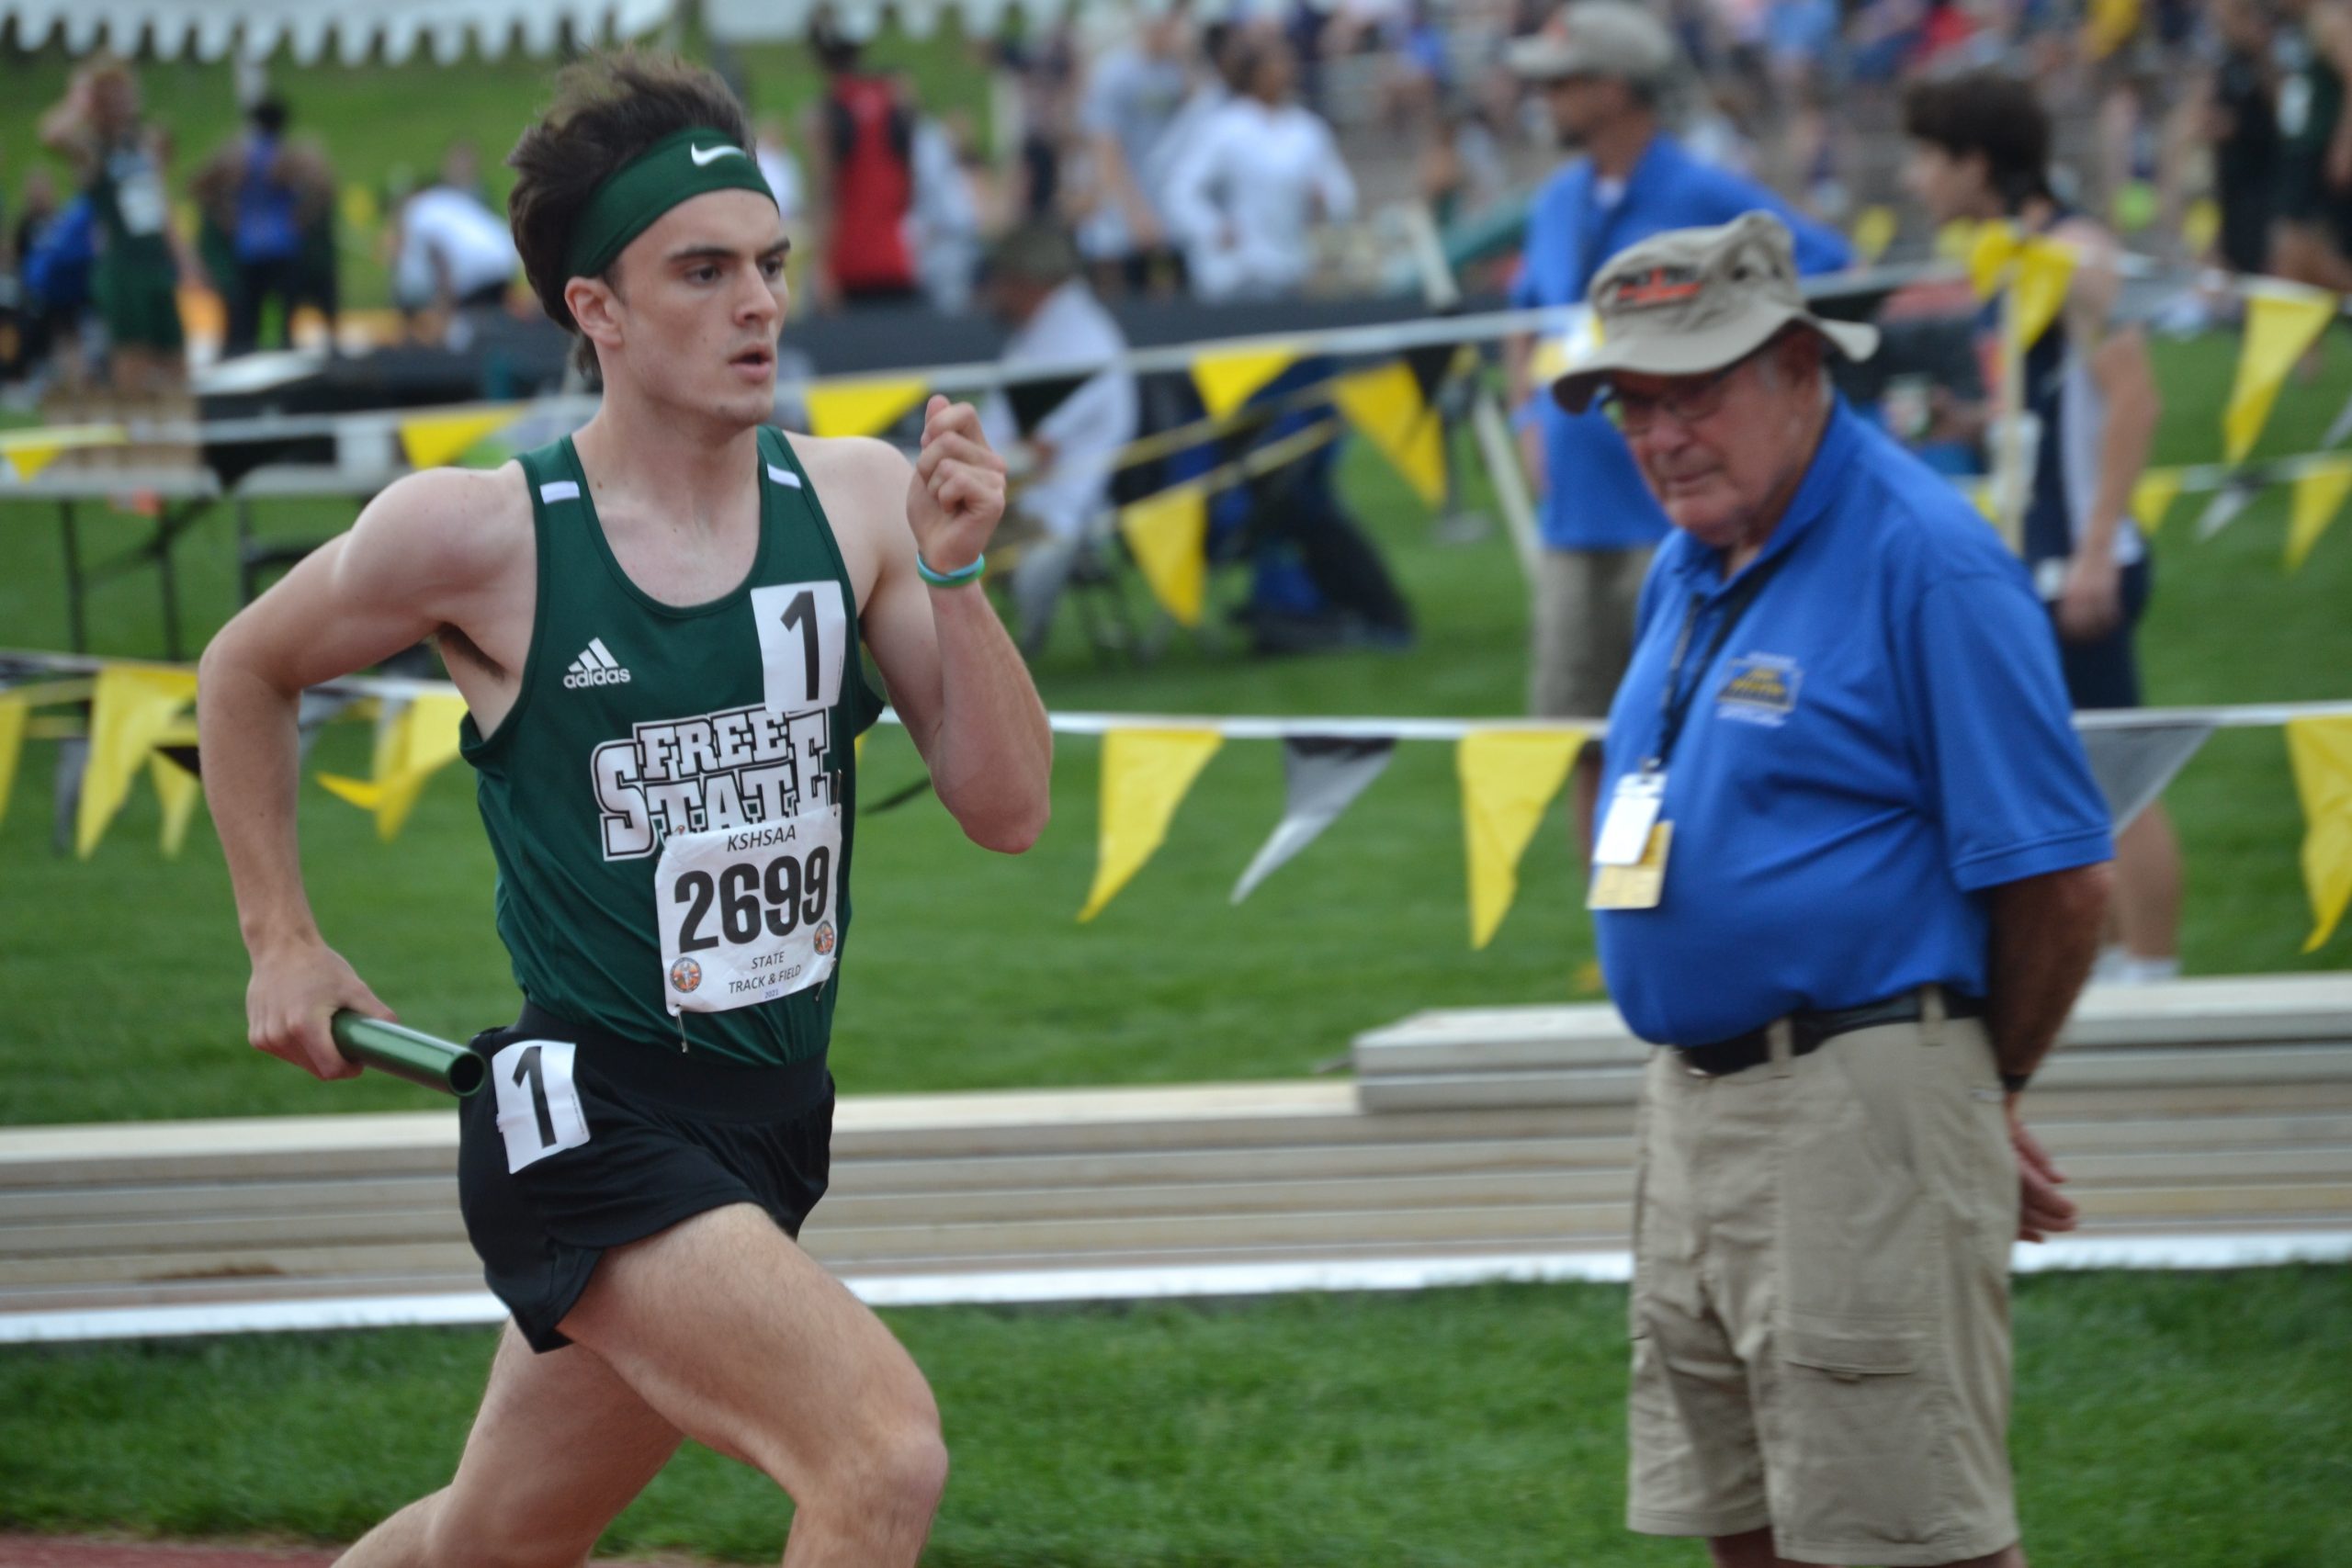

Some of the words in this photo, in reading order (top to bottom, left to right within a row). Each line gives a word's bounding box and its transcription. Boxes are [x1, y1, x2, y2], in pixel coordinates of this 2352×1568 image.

[563, 668, 631, 690] adidas
[780, 590, 820, 702] 1
[633, 704, 788, 783] FREE
[591, 706, 831, 862] STATE
[727, 825, 797, 852] KSHSAA
[674, 845, 830, 953] 2699
[729, 976, 764, 994] TRACK
[768, 972, 776, 986] &
[778, 964, 802, 982] FIELD
[752, 951, 785, 970] STATE
[512, 1045, 557, 1150] 1
